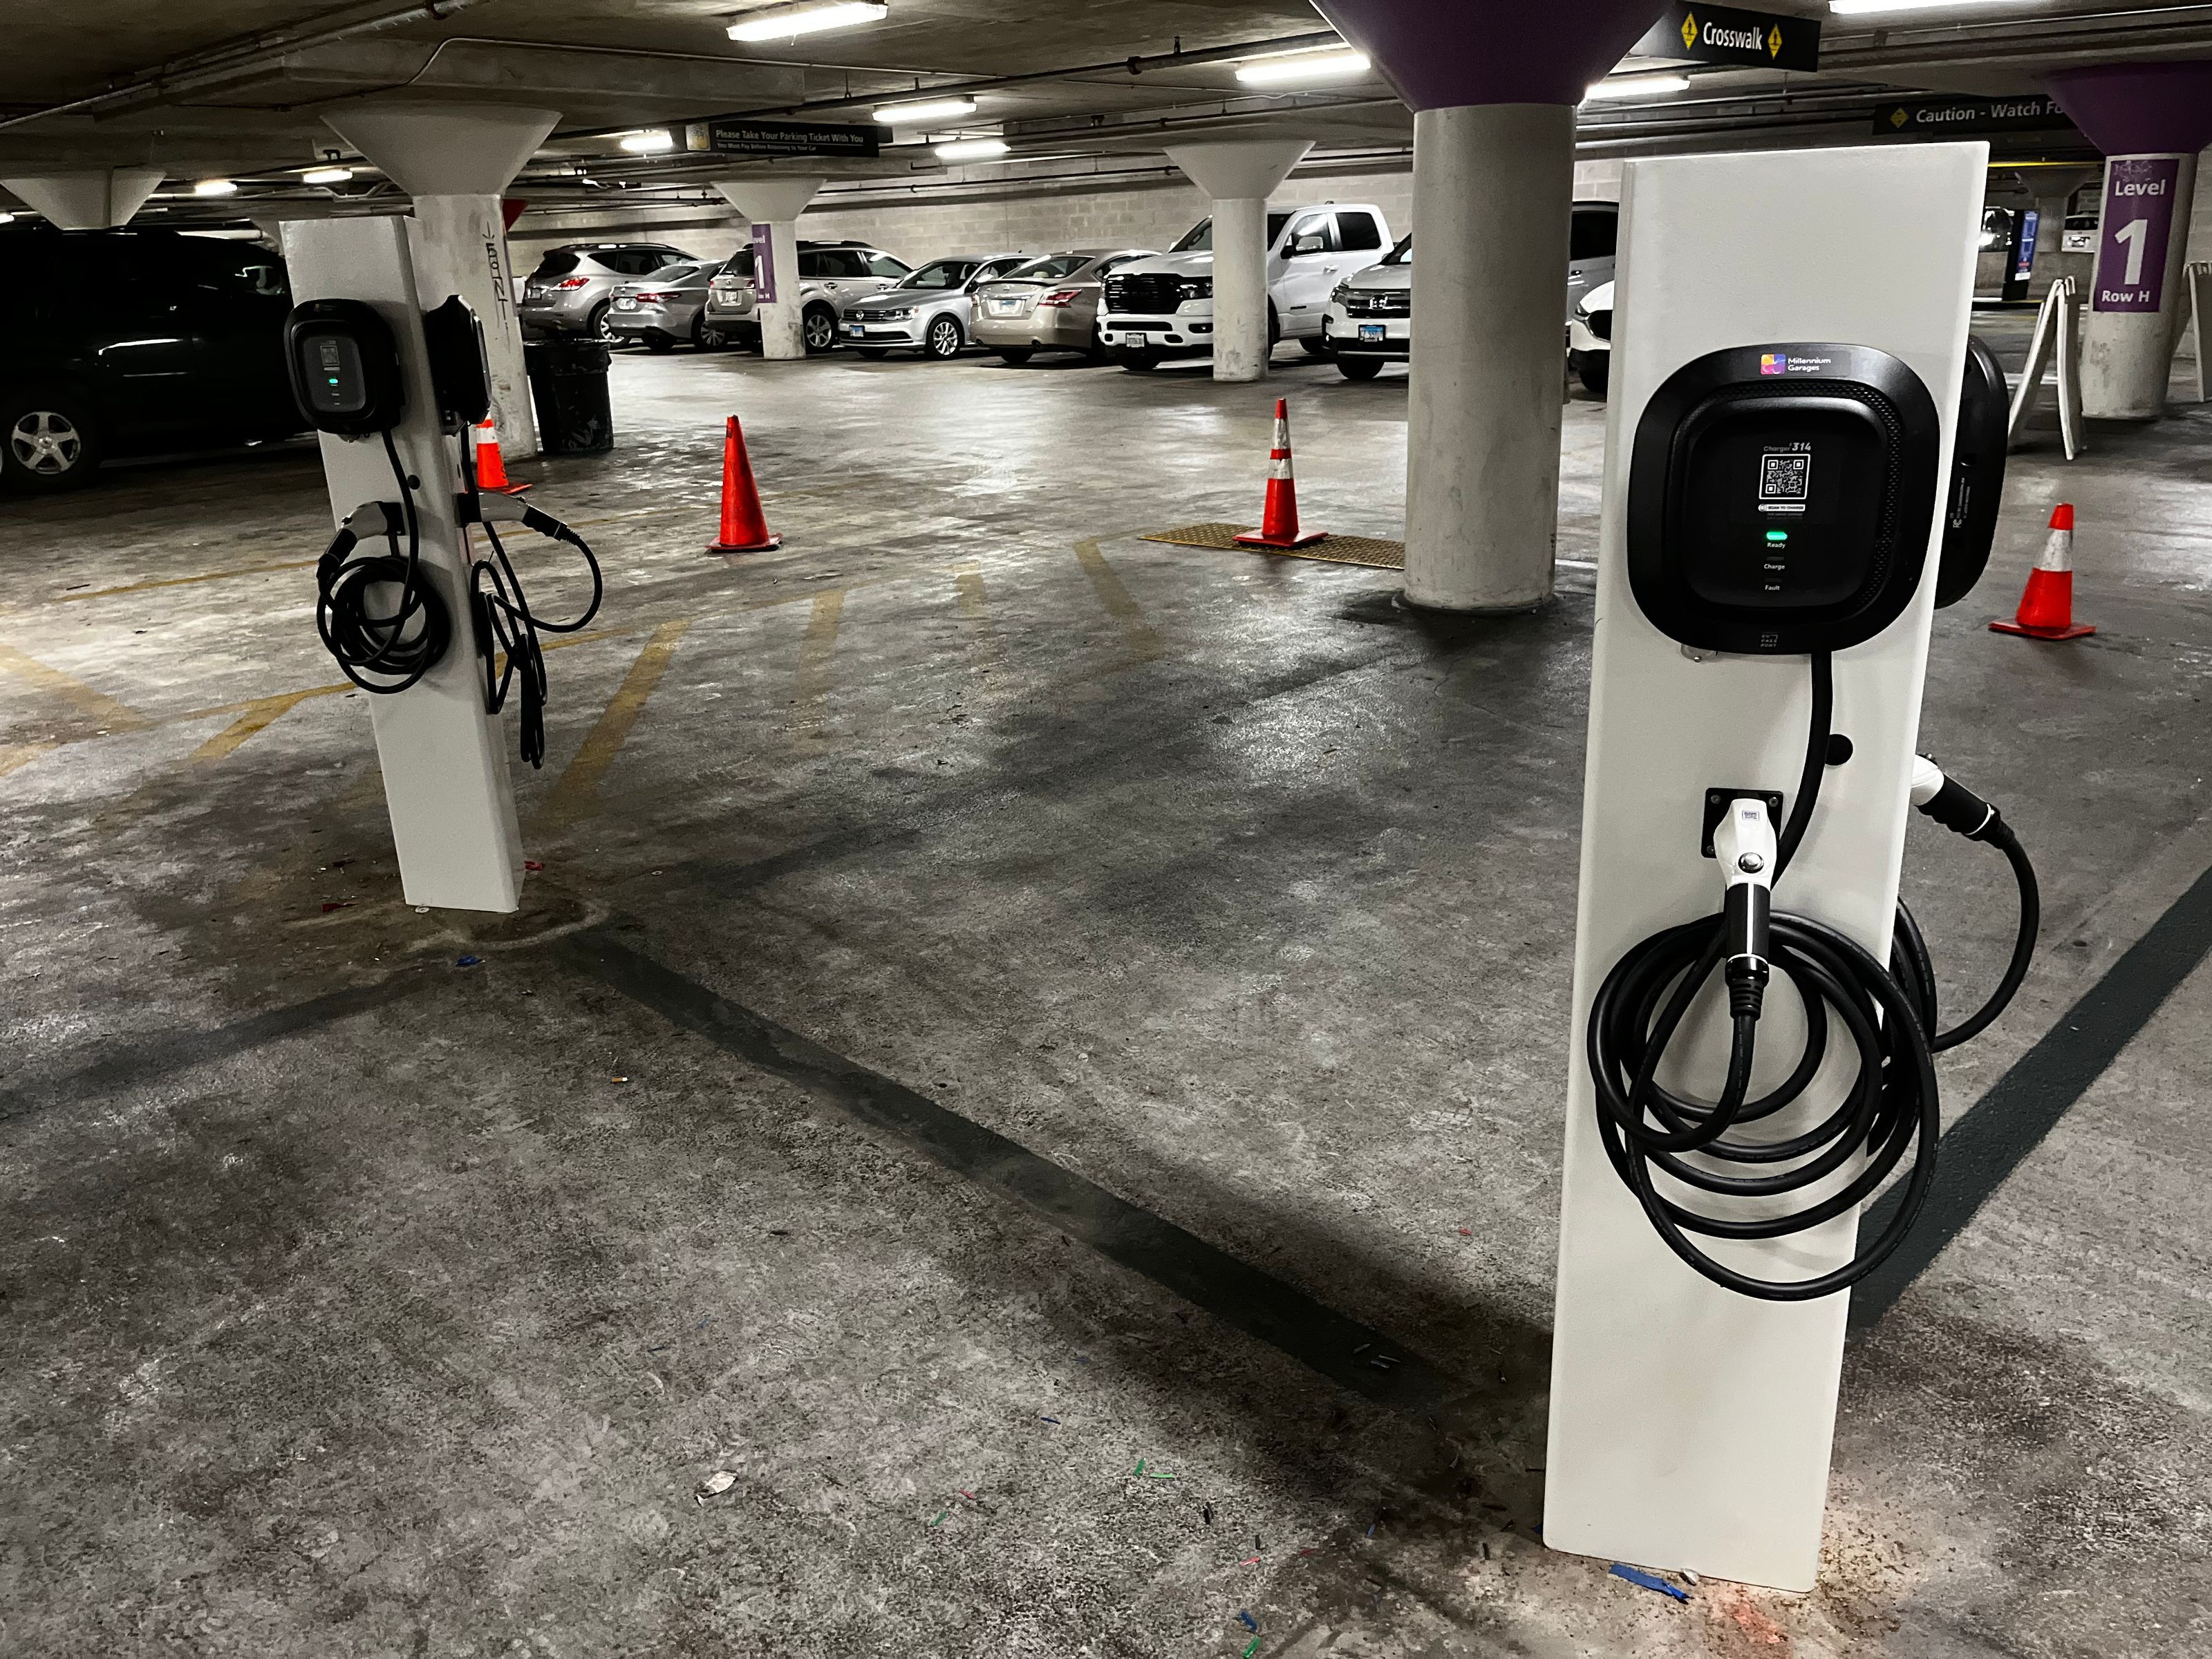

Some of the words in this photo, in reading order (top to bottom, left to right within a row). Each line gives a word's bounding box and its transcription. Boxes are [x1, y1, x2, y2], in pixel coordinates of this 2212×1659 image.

[1703, 21, 1763, 50] Crosswalk
[1915, 107, 1976, 123] Caution
[1991, 102, 2041, 118] Watch
[2046, 102, 2063, 115] Fo
[715, 129, 740, 138] Please
[742, 130, 759, 139] Take
[760, 131, 778, 140] Your
[780, 131, 807, 142] Parking
[809, 133, 830, 142] Ticket
[831, 133, 849, 142] With
[850, 134, 863, 142] You
[2115, 178, 2166, 196] Level
[2115, 219, 2148, 285] 1
[755, 255, 765, 289] 1
[2101, 290, 2134, 303] Row
[2138, 290, 2150, 303] H
[1788, 364, 1820, 373] Garages
